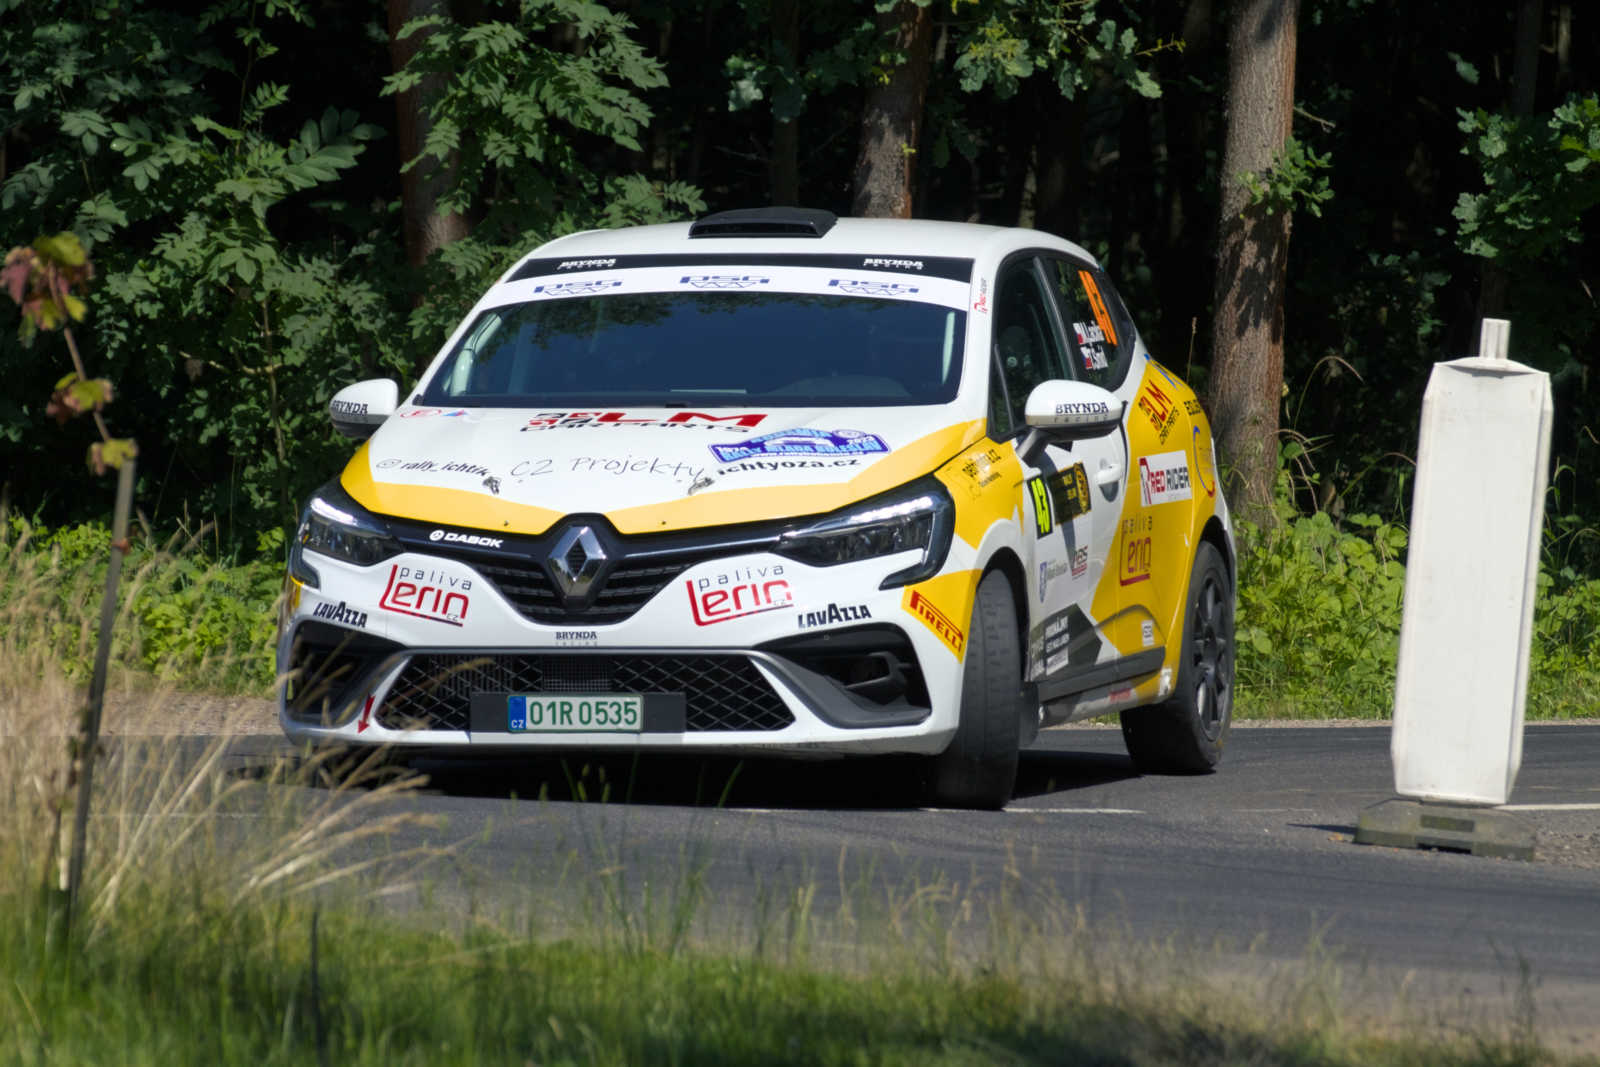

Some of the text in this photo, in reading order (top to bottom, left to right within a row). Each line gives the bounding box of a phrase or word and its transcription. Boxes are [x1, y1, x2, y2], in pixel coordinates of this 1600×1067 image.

[1055, 401, 1109, 414] BRYNDA
[1149, 466, 1190, 493] RED RIDER
[444, 531, 504, 549] DABOK
[399, 566, 472, 591] paliva
[698, 564, 785, 592] paliva
[379, 564, 470, 627] Lerin
[313, 601, 368, 629] LAVAZZA
[797, 603, 873, 629] LAVAZZA
[909, 590, 965, 655] PIRELLI
[555, 631, 598, 640] BRYNDA
[511, 719, 524, 729] CZ
[530, 701, 637, 725] 01R 0535
